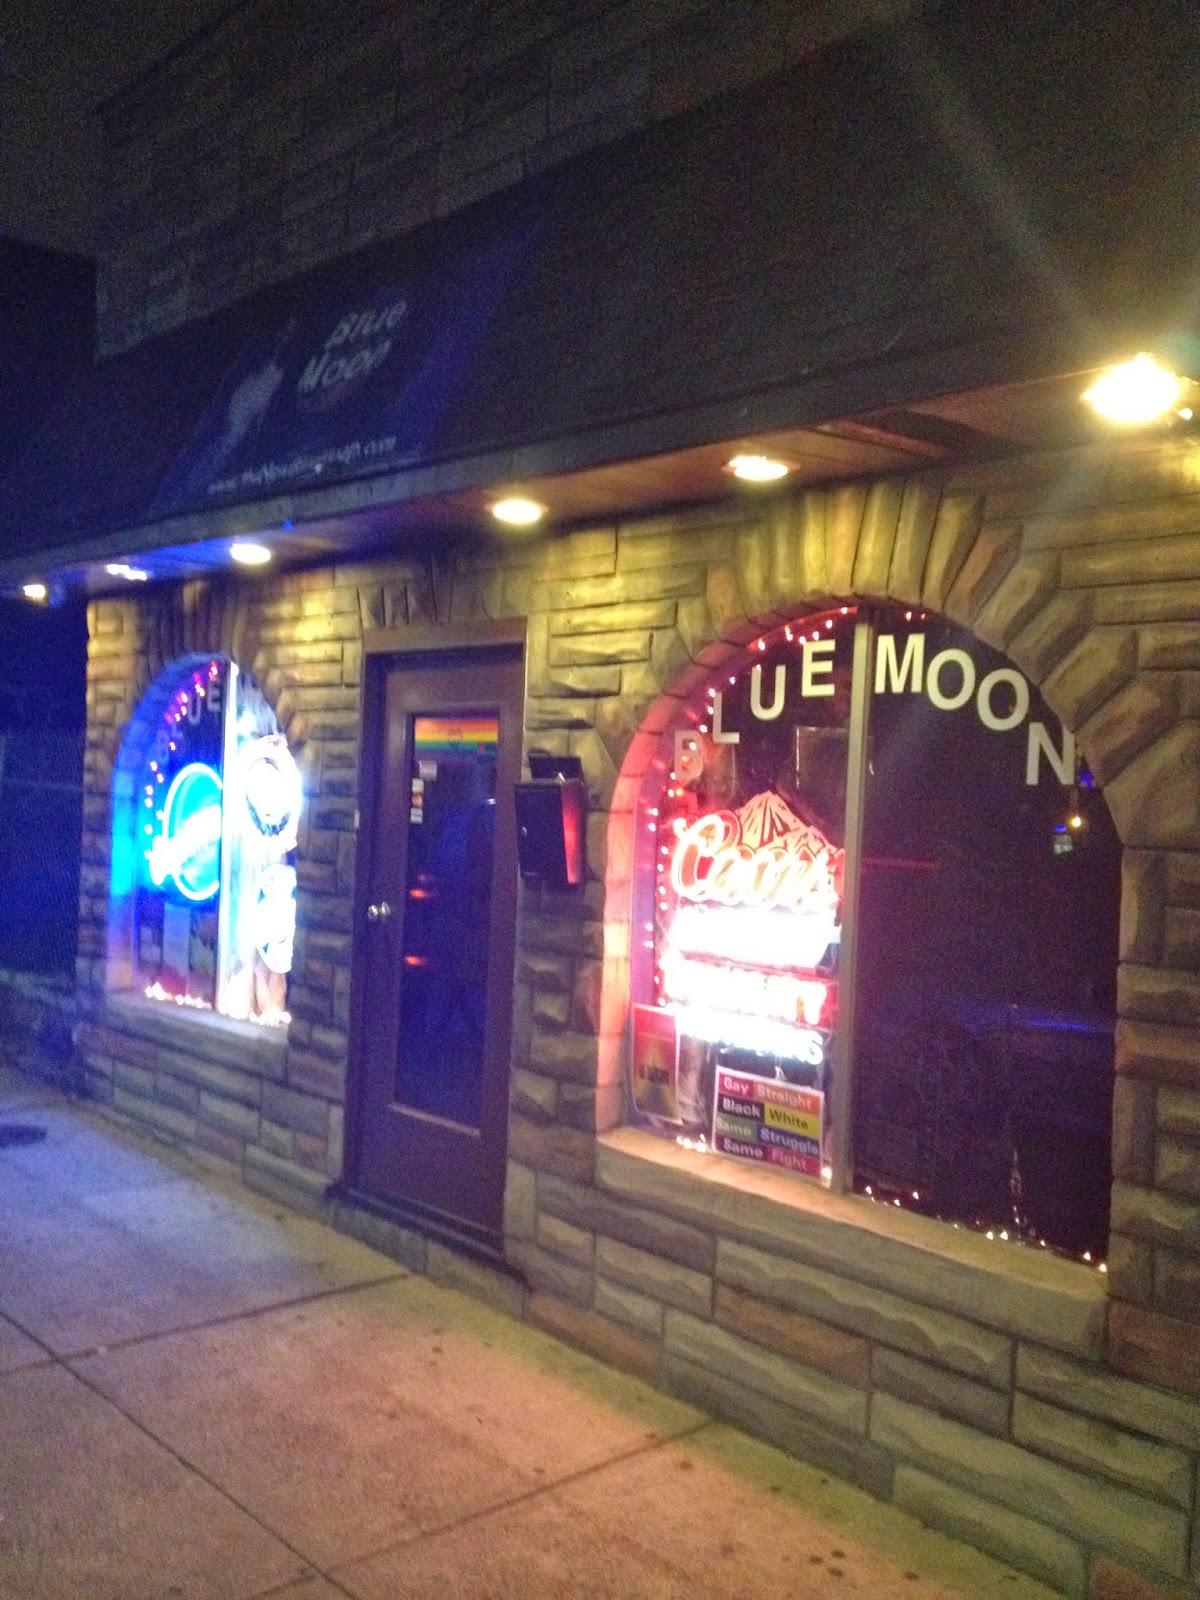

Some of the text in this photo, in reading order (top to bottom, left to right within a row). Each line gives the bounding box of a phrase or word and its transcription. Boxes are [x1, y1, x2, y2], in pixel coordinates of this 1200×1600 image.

[673, 632, 1076, 786] BLUE MOON
[723, 1076, 813, 1111] Gay Straight
[722, 1097, 809, 1130] Black White
[715, 1115, 819, 1155] Same Struggle
[723, 1138, 808, 1172] Same Fight
